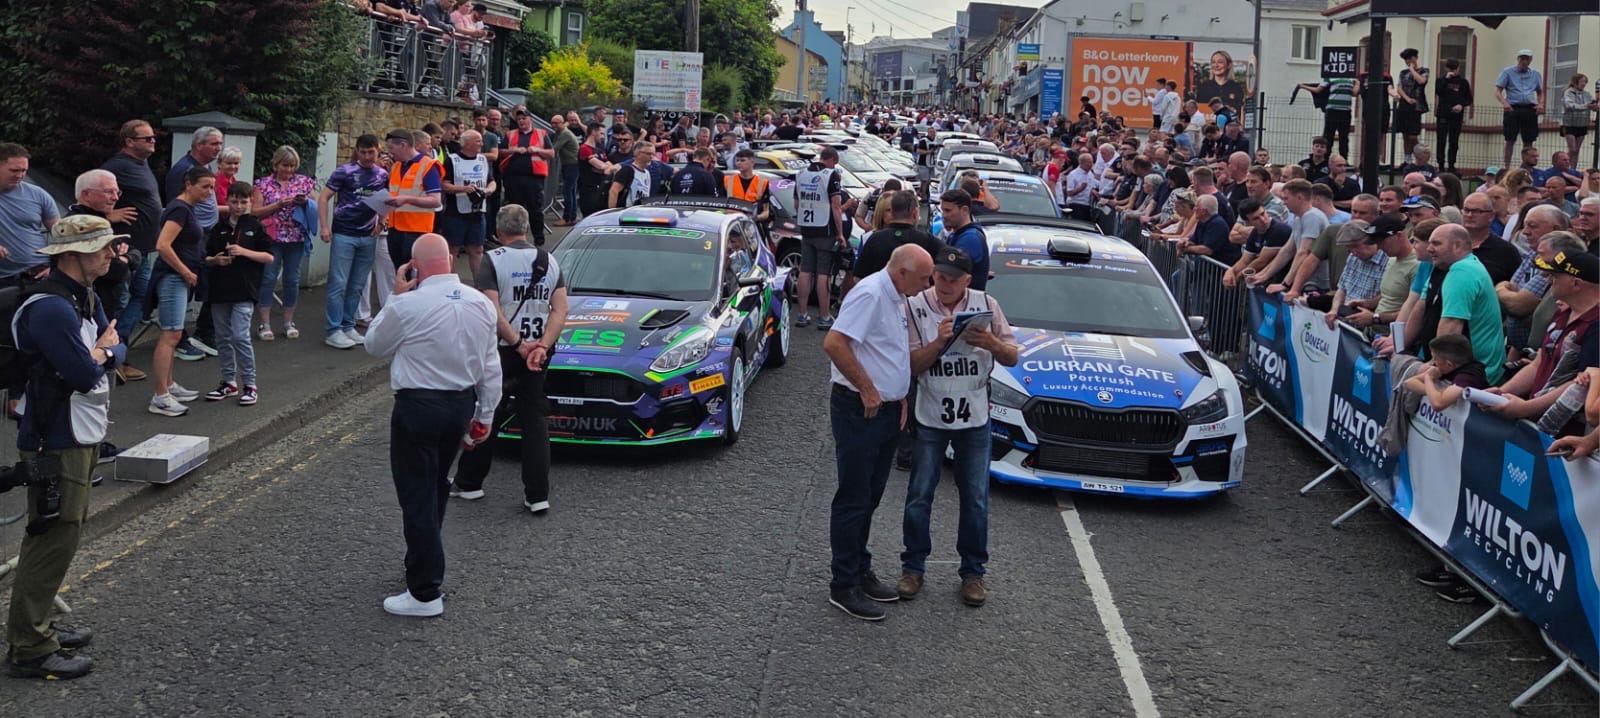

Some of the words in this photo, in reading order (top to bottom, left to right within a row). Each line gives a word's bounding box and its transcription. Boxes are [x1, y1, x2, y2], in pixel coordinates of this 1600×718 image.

[1083, 50, 1109, 60] B&Q
[1111, 51, 1179, 64] Letterkenny
[1329, 52, 1353, 62] NEW
[1083, 64, 1150, 85] now
[801, 192, 821, 201] Media
[804, 210, 814, 223] 21
[587, 227, 700, 239] MOTOWORLD
[704, 241, 712, 250] 3
[520, 317, 543, 339] 53
[557, 329, 626, 346] KES
[1304, 331, 1330, 356] DONEGAL
[930, 357, 979, 377] Media
[1022, 360, 1113, 374] CURRAN
[1118, 365, 1176, 384] GATE
[693, 376, 722, 391] PIRELLI
[1069, 374, 1135, 387] Portrush
[1043, 384, 1079, 392] Luxury
[1081, 384, 1165, 399] Accommodation
[942, 397, 971, 424] 34
[1420, 403, 1452, 434] ONEGAL
[1331, 424, 1384, 469] RECYCLING
[1465, 488, 1566, 591] WILTON
[1464, 526, 1554, 602] RECYCLING
